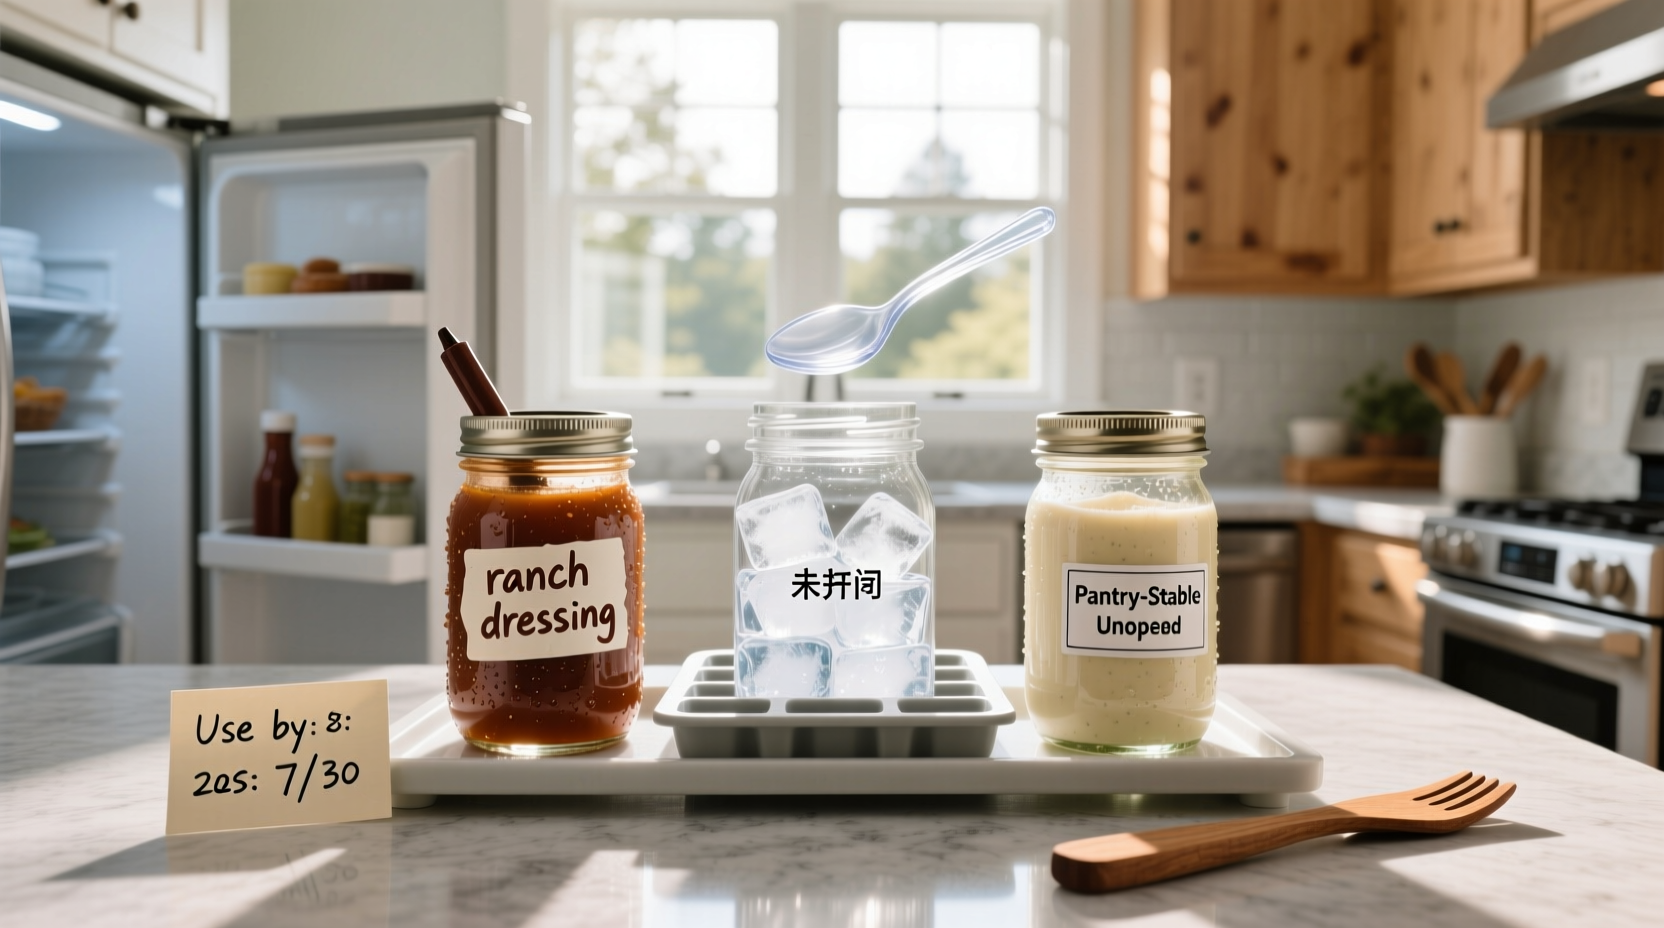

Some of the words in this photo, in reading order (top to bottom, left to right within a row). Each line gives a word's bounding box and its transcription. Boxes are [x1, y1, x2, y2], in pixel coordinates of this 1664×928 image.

[486, 550, 590, 596] ranch
[1075, 584, 1201, 611] Pantry-Stable
[480, 600, 616, 644] dressing
[196, 713, 255, 745] Use
[274, 752, 360, 804] 7/30
